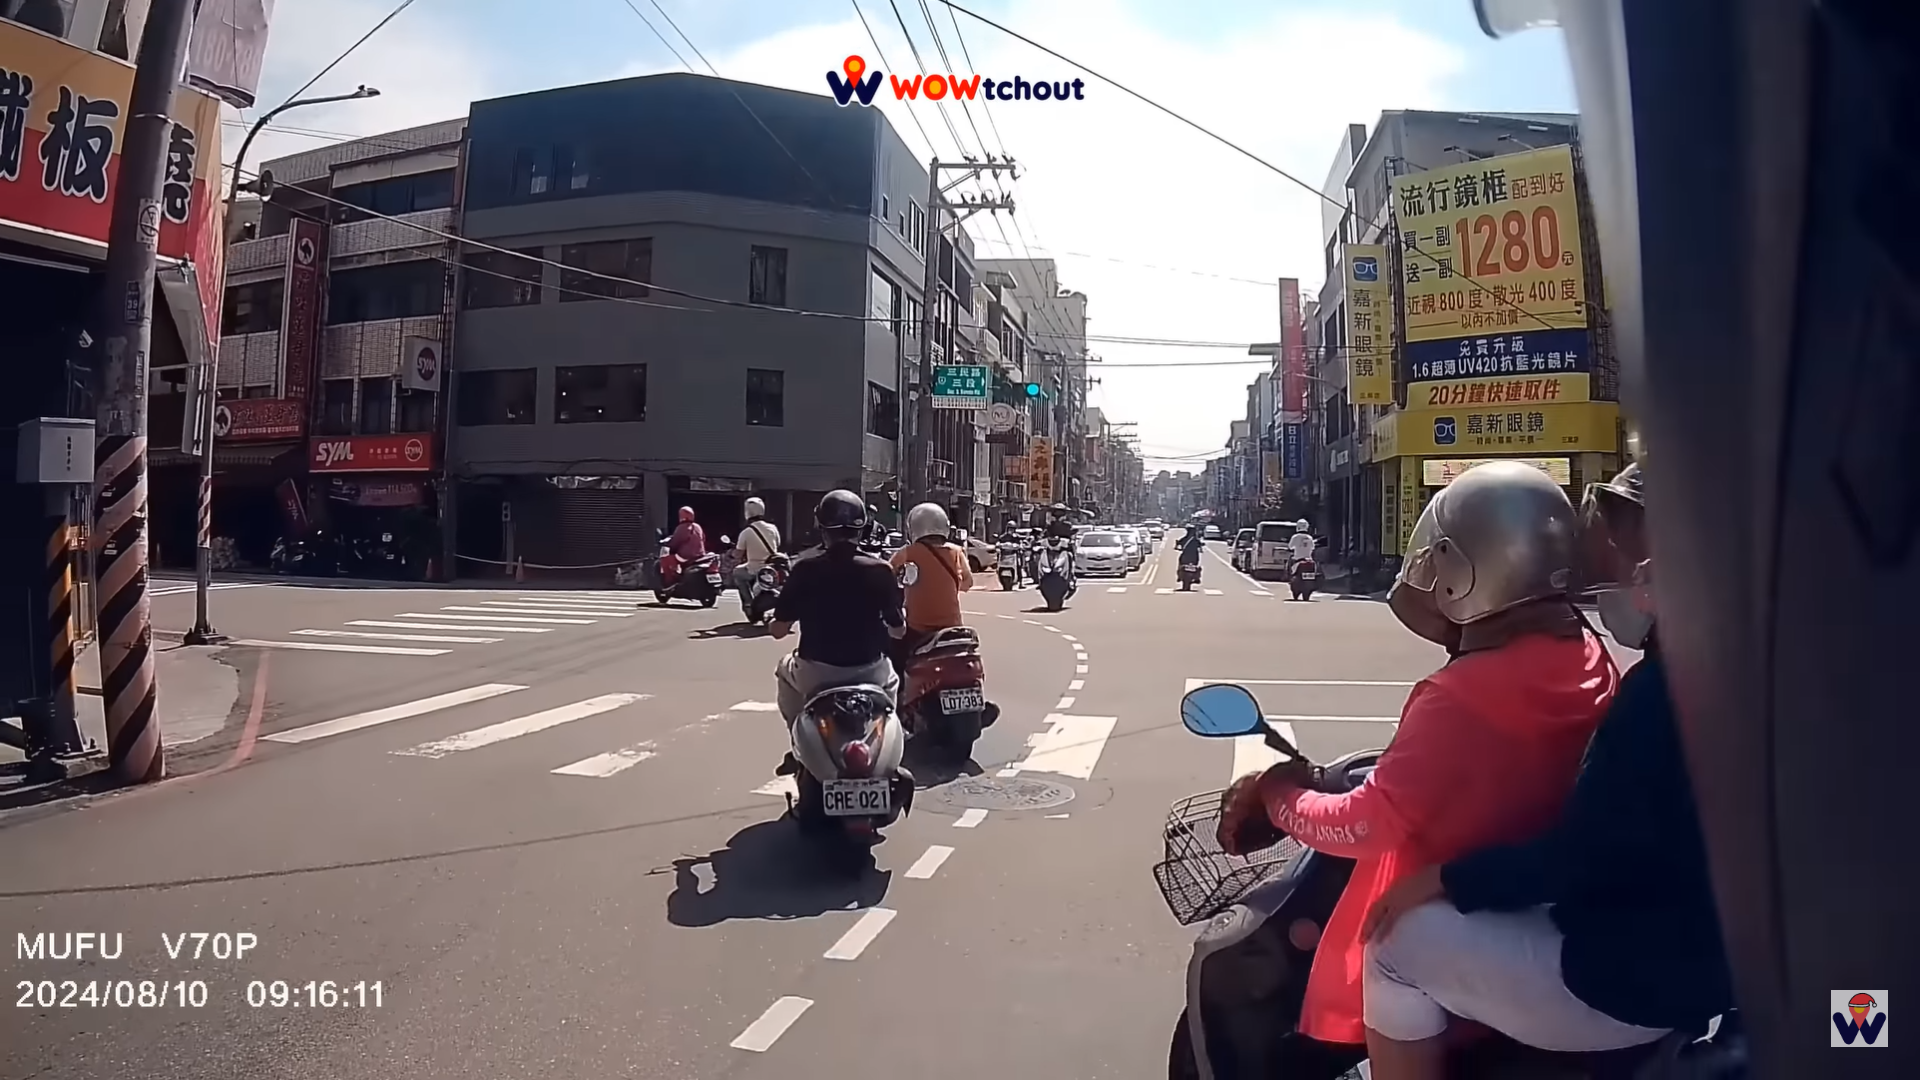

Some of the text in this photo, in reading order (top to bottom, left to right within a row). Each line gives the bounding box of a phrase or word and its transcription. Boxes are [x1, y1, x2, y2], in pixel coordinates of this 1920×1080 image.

[1400, 169, 1565, 218] 流行鏡框 配到好
[1403, 224, 1451, 251] 買一副
[1455, 205, 1574, 278] 1280 元
[1405, 256, 1453, 285] 送一副
[1353, 289, 1374, 377] 嘉新眼鏡
[417, 357, 436, 373] SYM
[1467, 412, 1544, 435] 嘉新眼鏡
[316, 442, 354, 467] SYM
